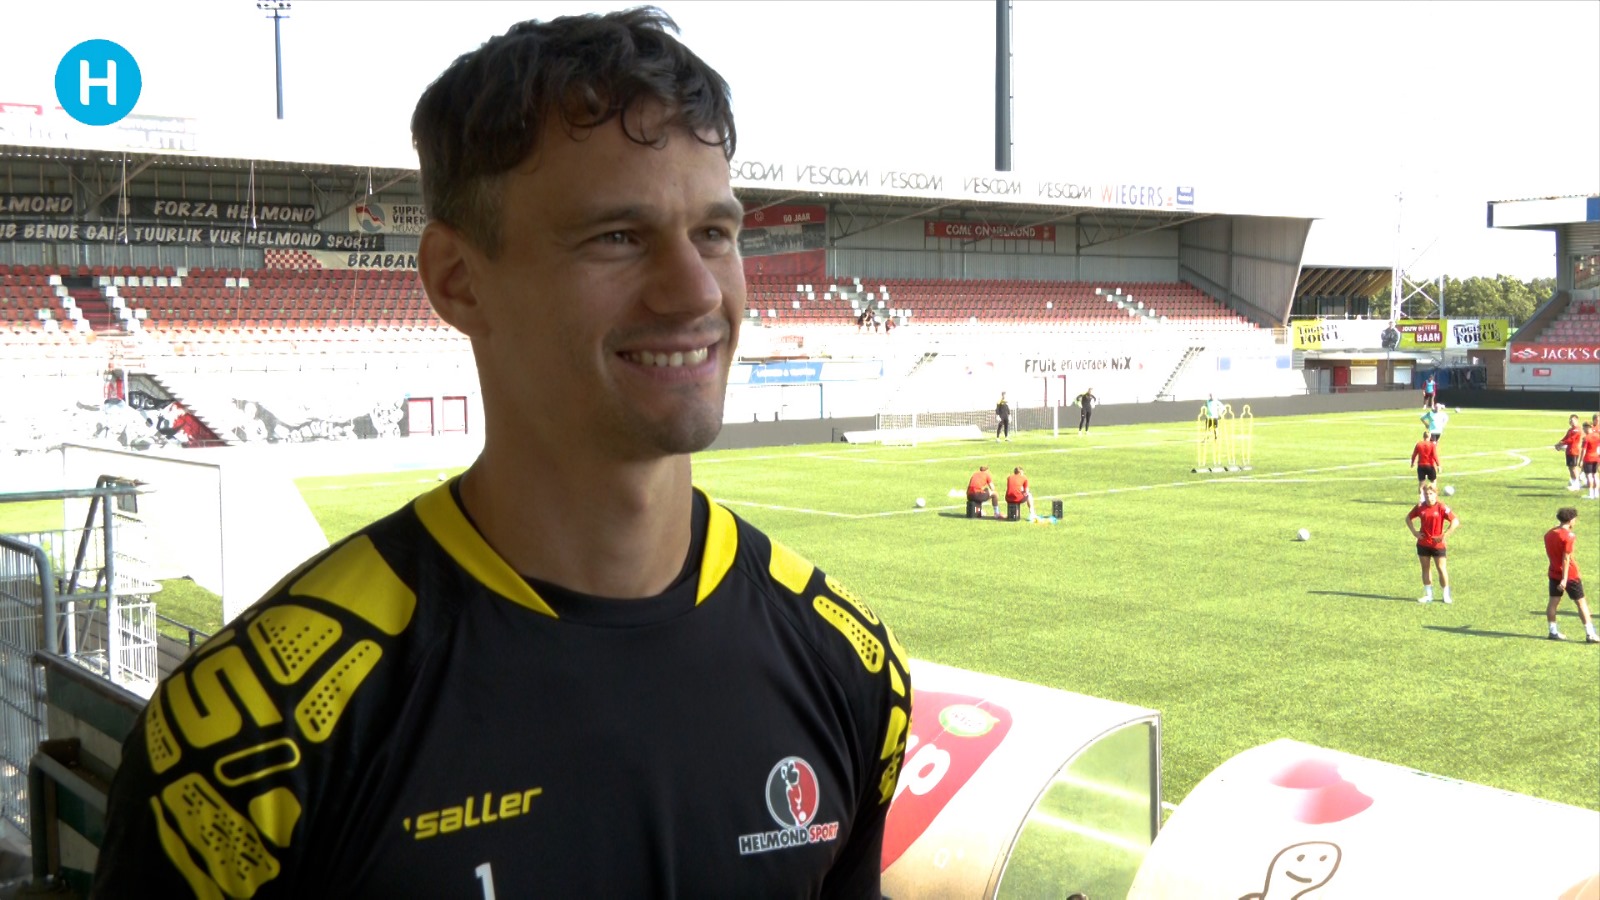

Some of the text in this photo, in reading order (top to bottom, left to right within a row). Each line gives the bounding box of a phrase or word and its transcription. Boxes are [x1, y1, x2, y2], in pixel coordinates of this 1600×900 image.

[730, 161, 783, 181] SCOM
[797, 165, 868, 187] VESCOM
[880, 171, 943, 191] VESCOM
[963, 176, 1021, 195] VESCOM
[1038, 181, 1092, 199] VESCOM
[0, 196, 73, 212] LMOND
[1101, 184, 1163, 207] WIEGERS
[154, 200, 315, 222] FORZA HELMOND
[392, 205, 426, 215] SUPPO
[392, 215, 427, 224] VEREN
[24, 223, 79, 239] BENDE
[134, 227, 203, 242] TUURLIK
[210, 229, 242, 244] VUR
[246, 231, 322, 247] HELMOND
[327, 234, 376, 249] SPORT!
[945, 224, 972, 236] COME
[975, 225, 990, 237] ON
[347, 253, 418, 269] BRABAN
[1417, 332, 1441, 342] BAAN
[1541, 347, 1590, 360] JACK'S
[740, 823, 838, 853] HELMOND SPORT
[475, 862, 496, 900] 1
